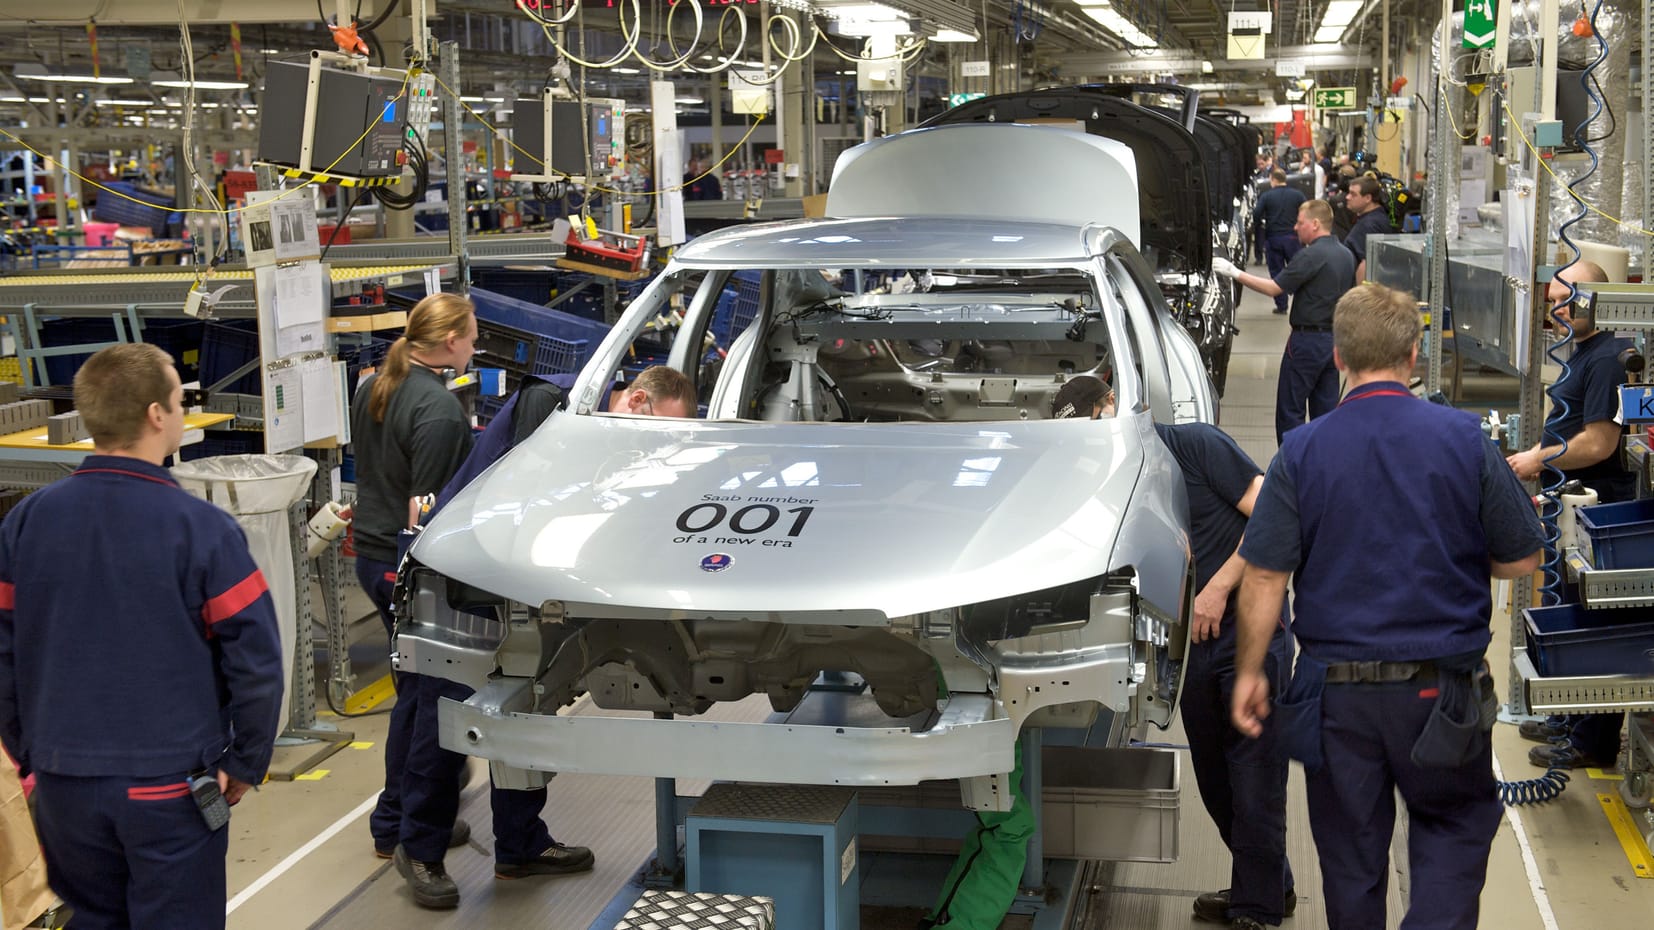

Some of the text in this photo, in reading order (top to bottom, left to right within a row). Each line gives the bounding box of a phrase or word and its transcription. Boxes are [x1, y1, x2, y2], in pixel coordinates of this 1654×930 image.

[700, 493, 819, 505] Saab number
[675, 502, 815, 537] 001
[672, 534, 793, 548] of a new era
